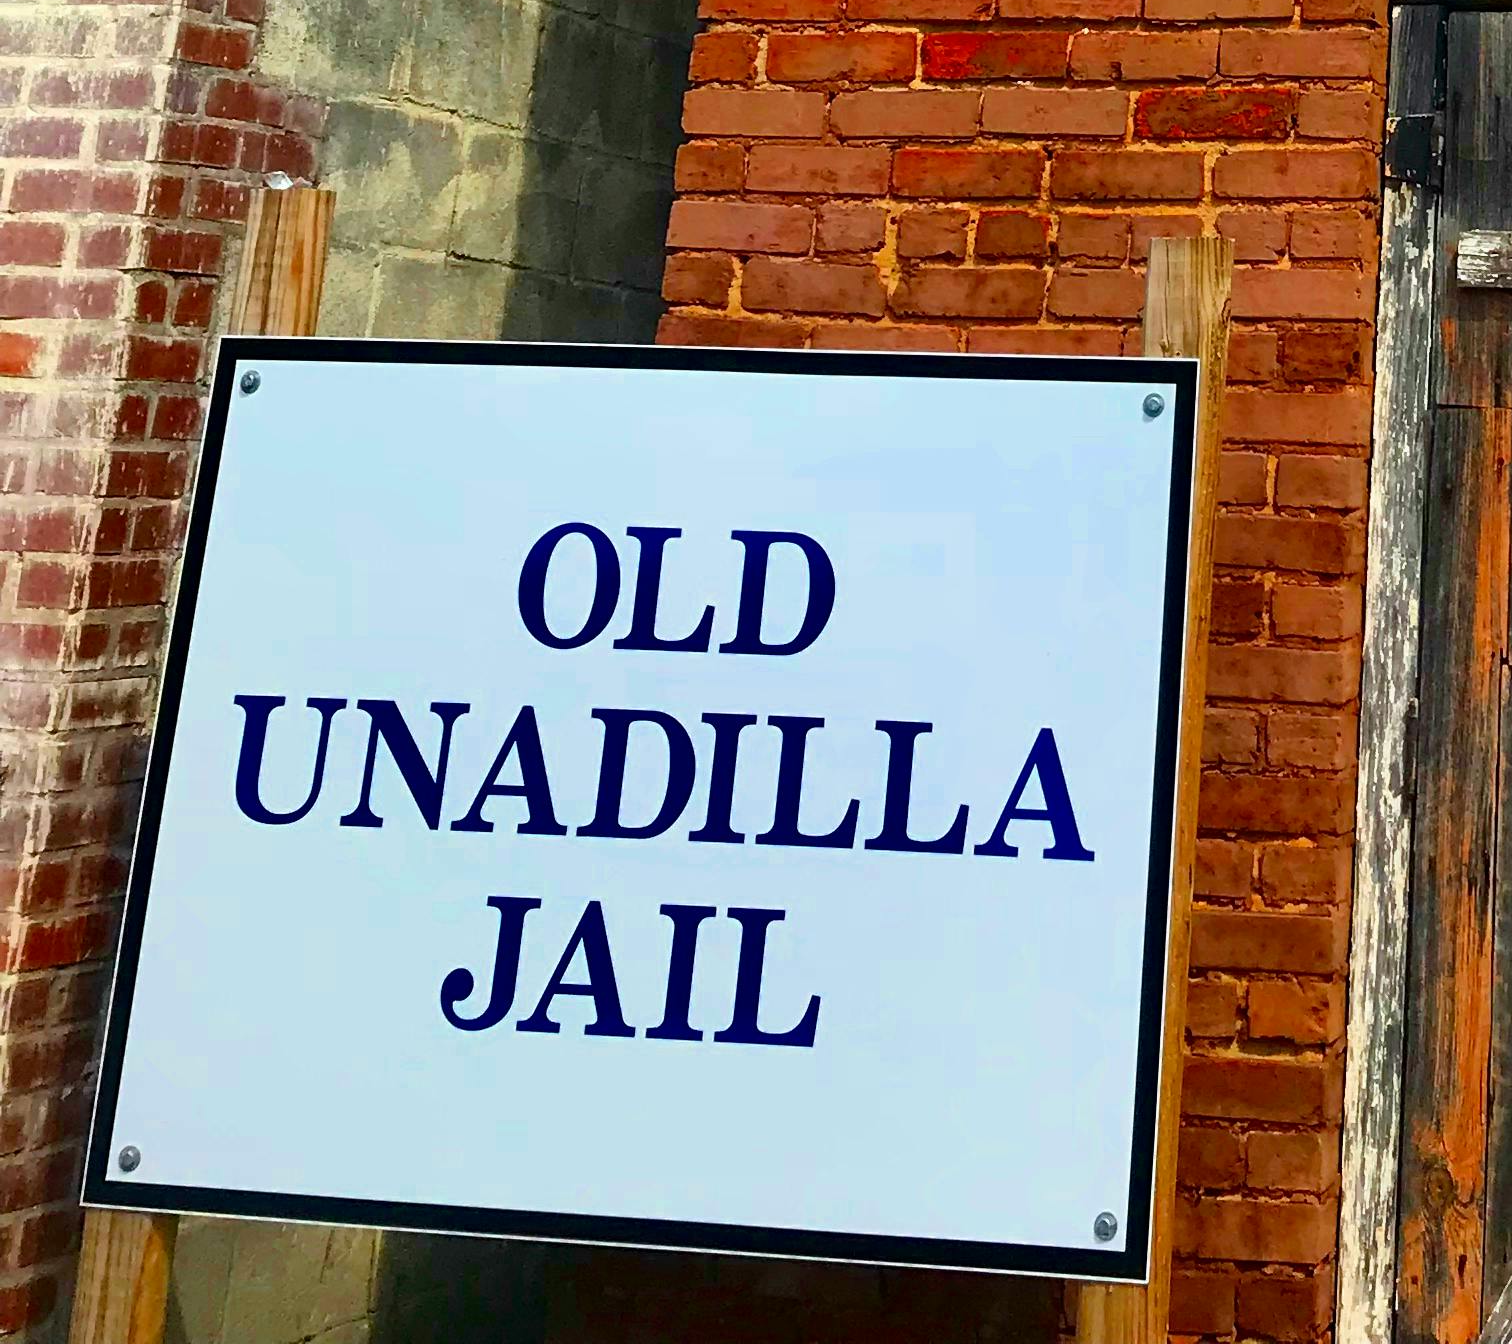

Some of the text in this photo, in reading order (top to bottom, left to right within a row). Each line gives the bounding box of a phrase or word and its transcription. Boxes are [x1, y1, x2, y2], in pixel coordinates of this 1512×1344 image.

[517, 522, 836, 657] OLD
[232, 694, 1096, 862] UNADILLA
[440, 895, 822, 1048] JAIL
